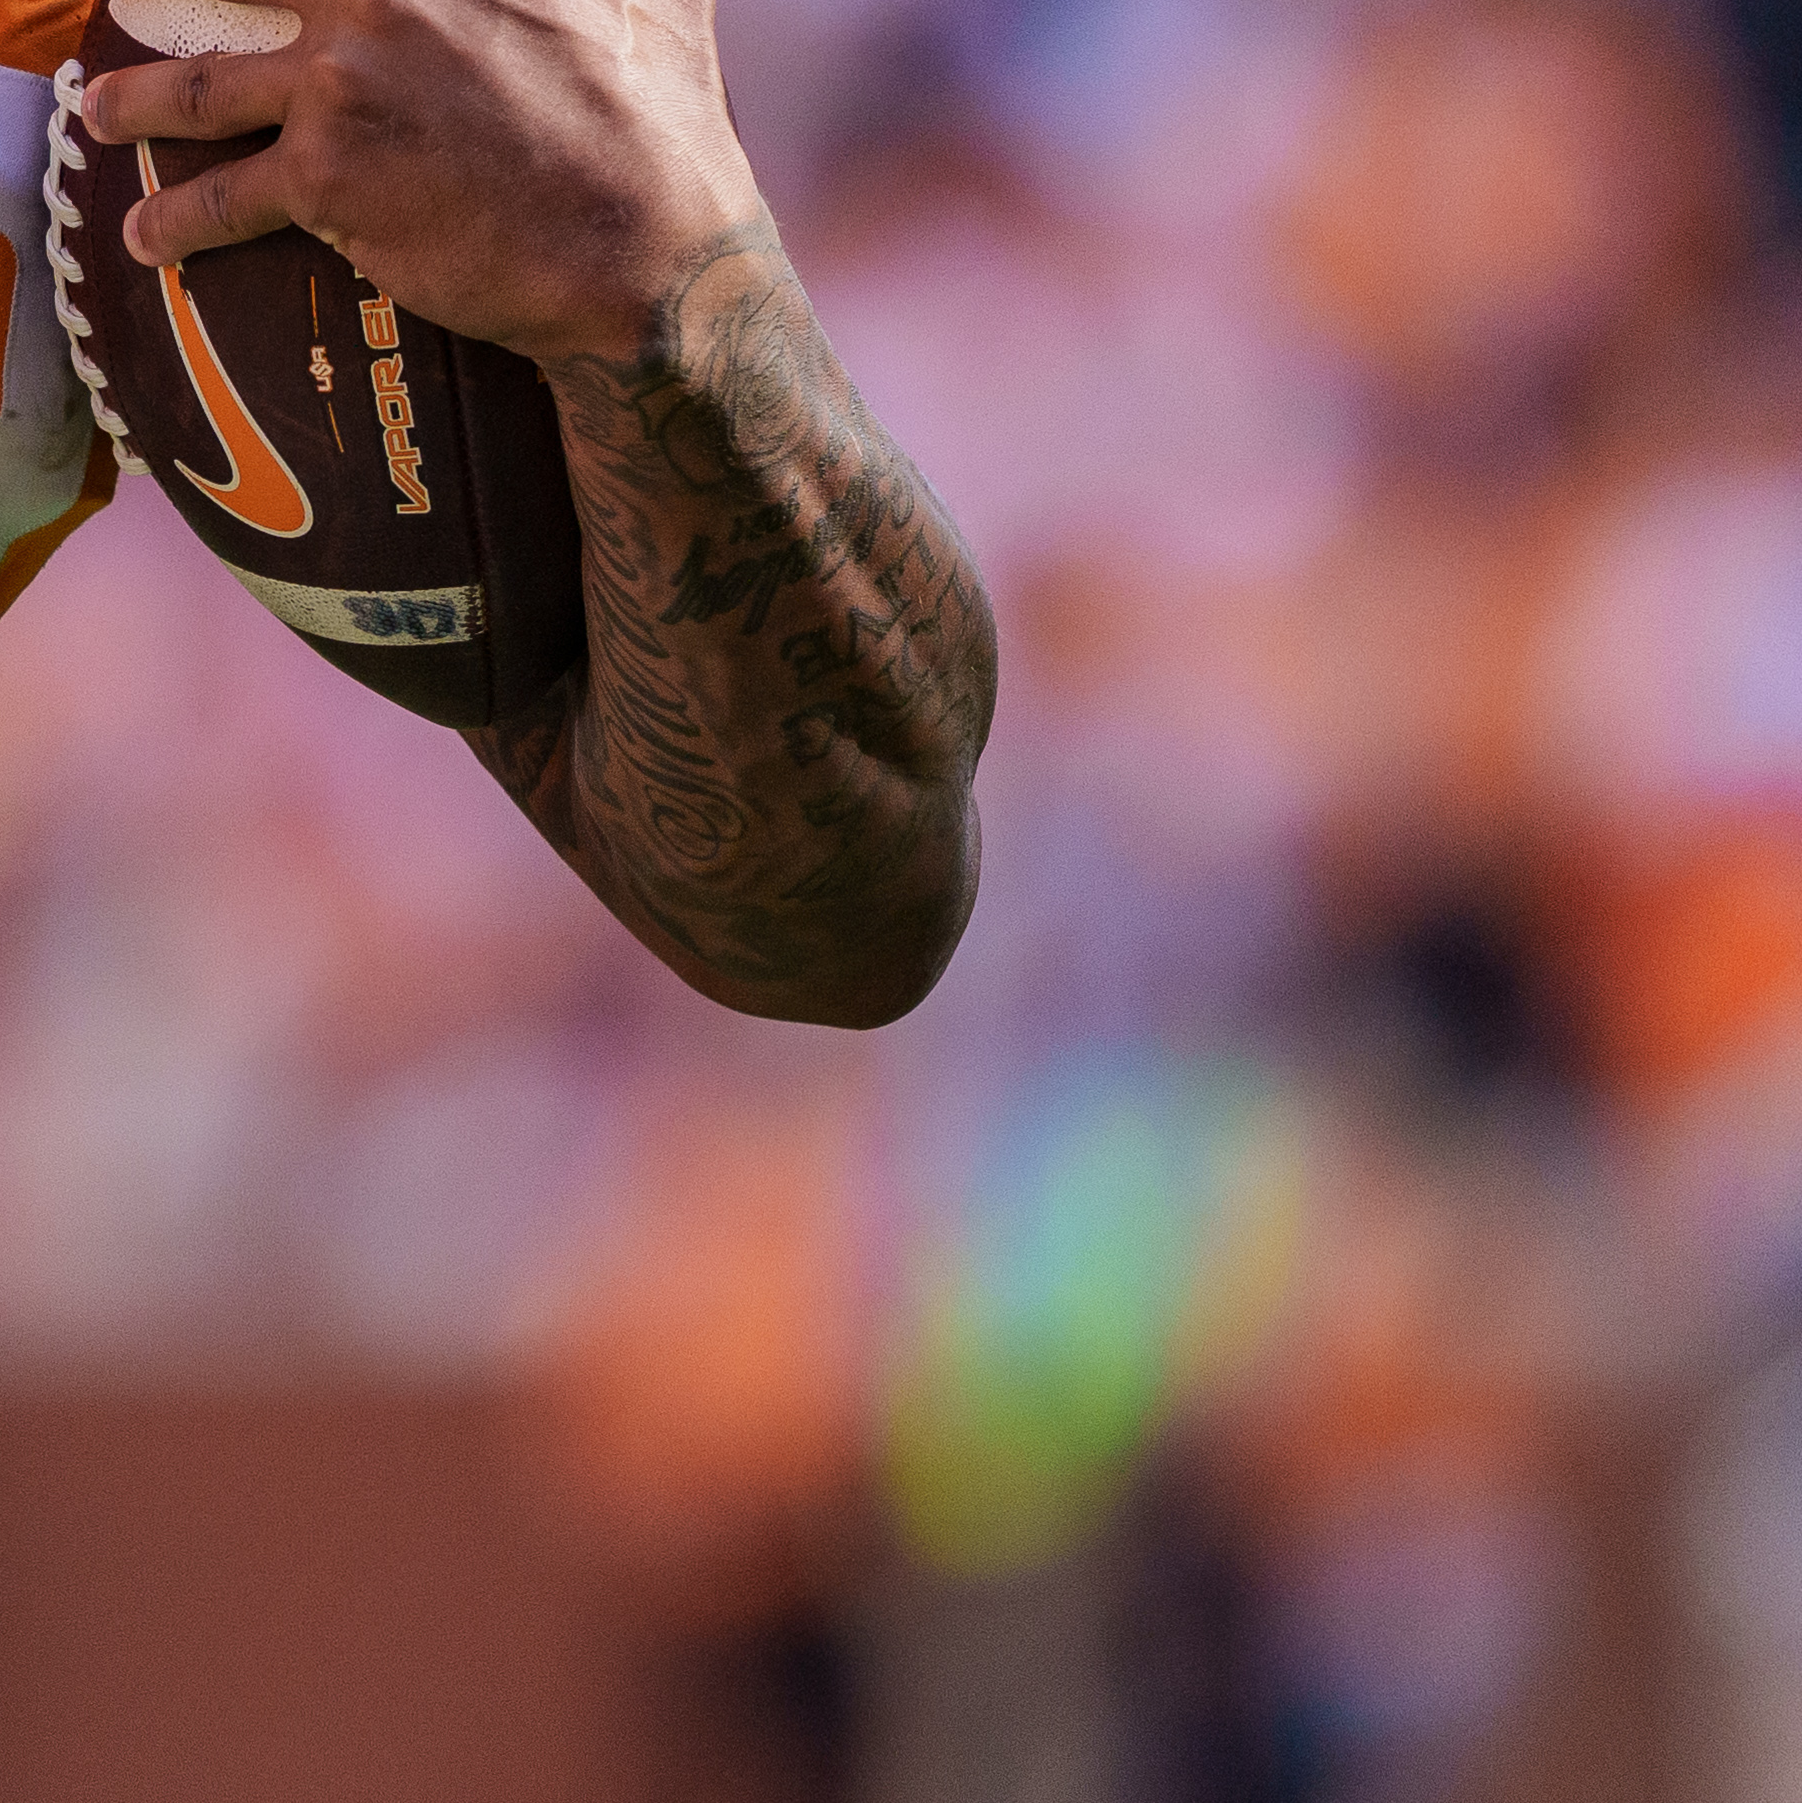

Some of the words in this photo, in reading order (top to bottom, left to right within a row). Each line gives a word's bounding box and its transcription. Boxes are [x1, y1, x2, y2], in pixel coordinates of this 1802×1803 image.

[354, 267, 400, 349] EL
[309, 345, 334, 392] USA
[371, 353, 431, 514] VAPOR
